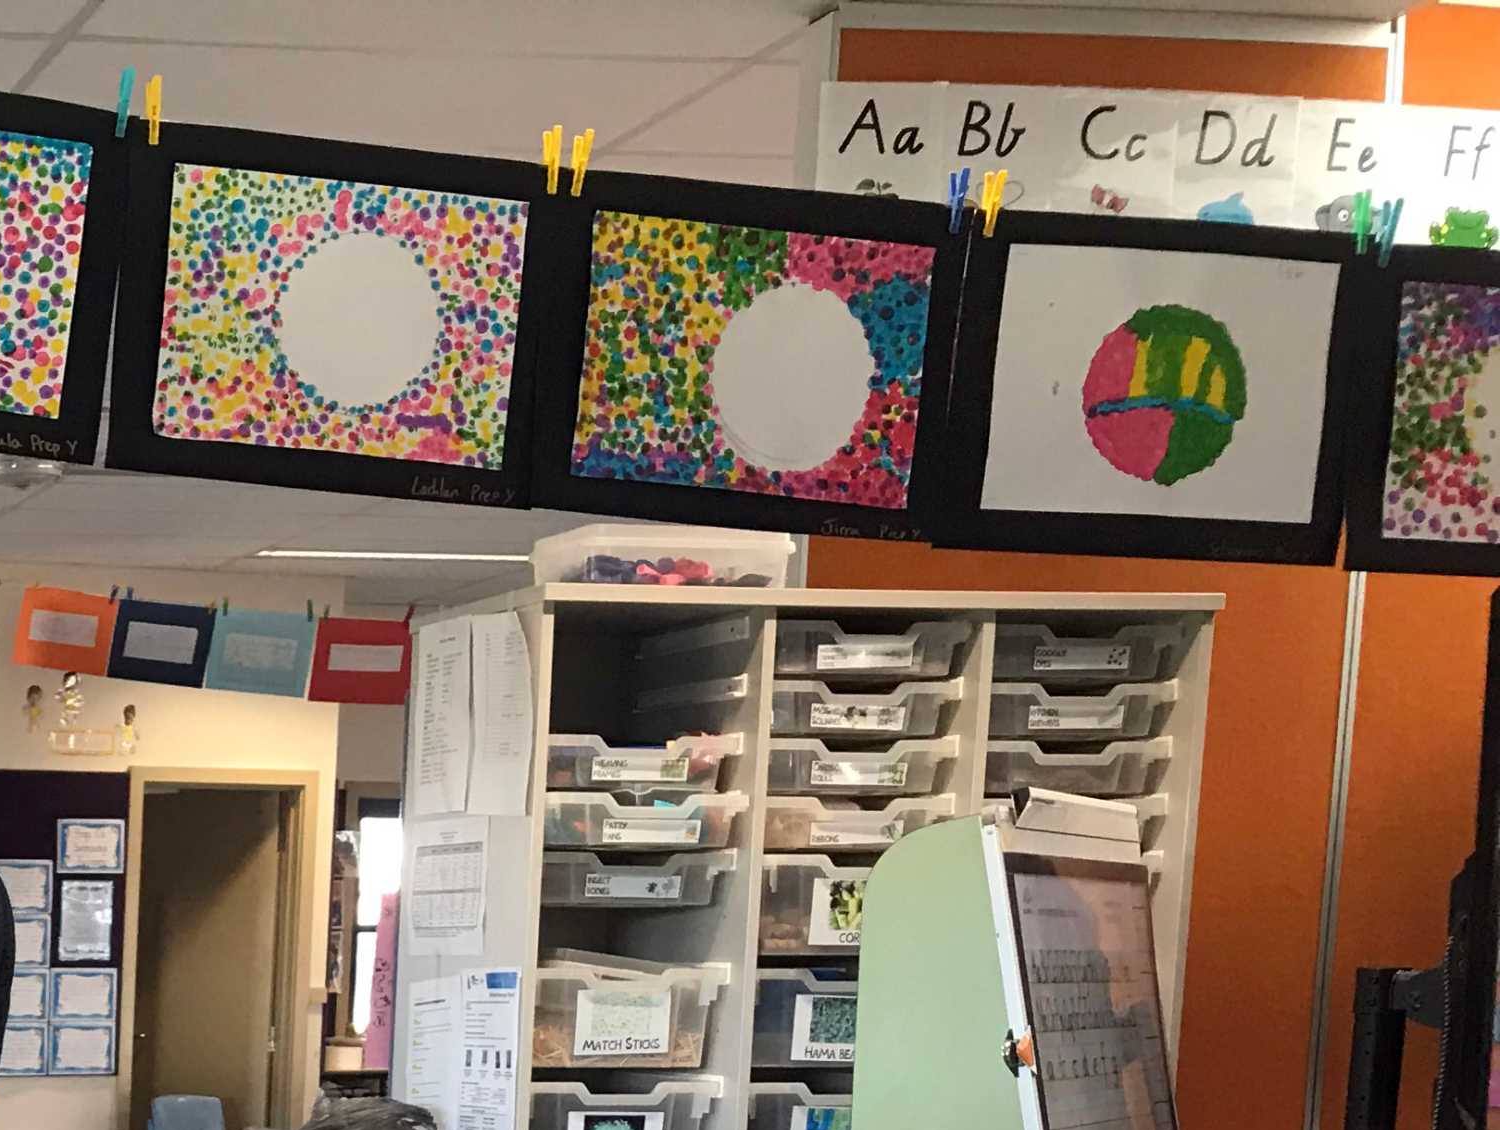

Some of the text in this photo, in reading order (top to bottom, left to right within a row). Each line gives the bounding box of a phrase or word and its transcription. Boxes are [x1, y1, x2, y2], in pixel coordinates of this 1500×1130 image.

[838, 98, 1500, 182] Aa Bb Cc Dd Ee Ff
[30, 433, 61, 457] Prep
[65, 439, 78, 456] Y
[582, 1036, 660, 1052] MATCH STICKS
[804, 1045, 836, 1060] HAMA
